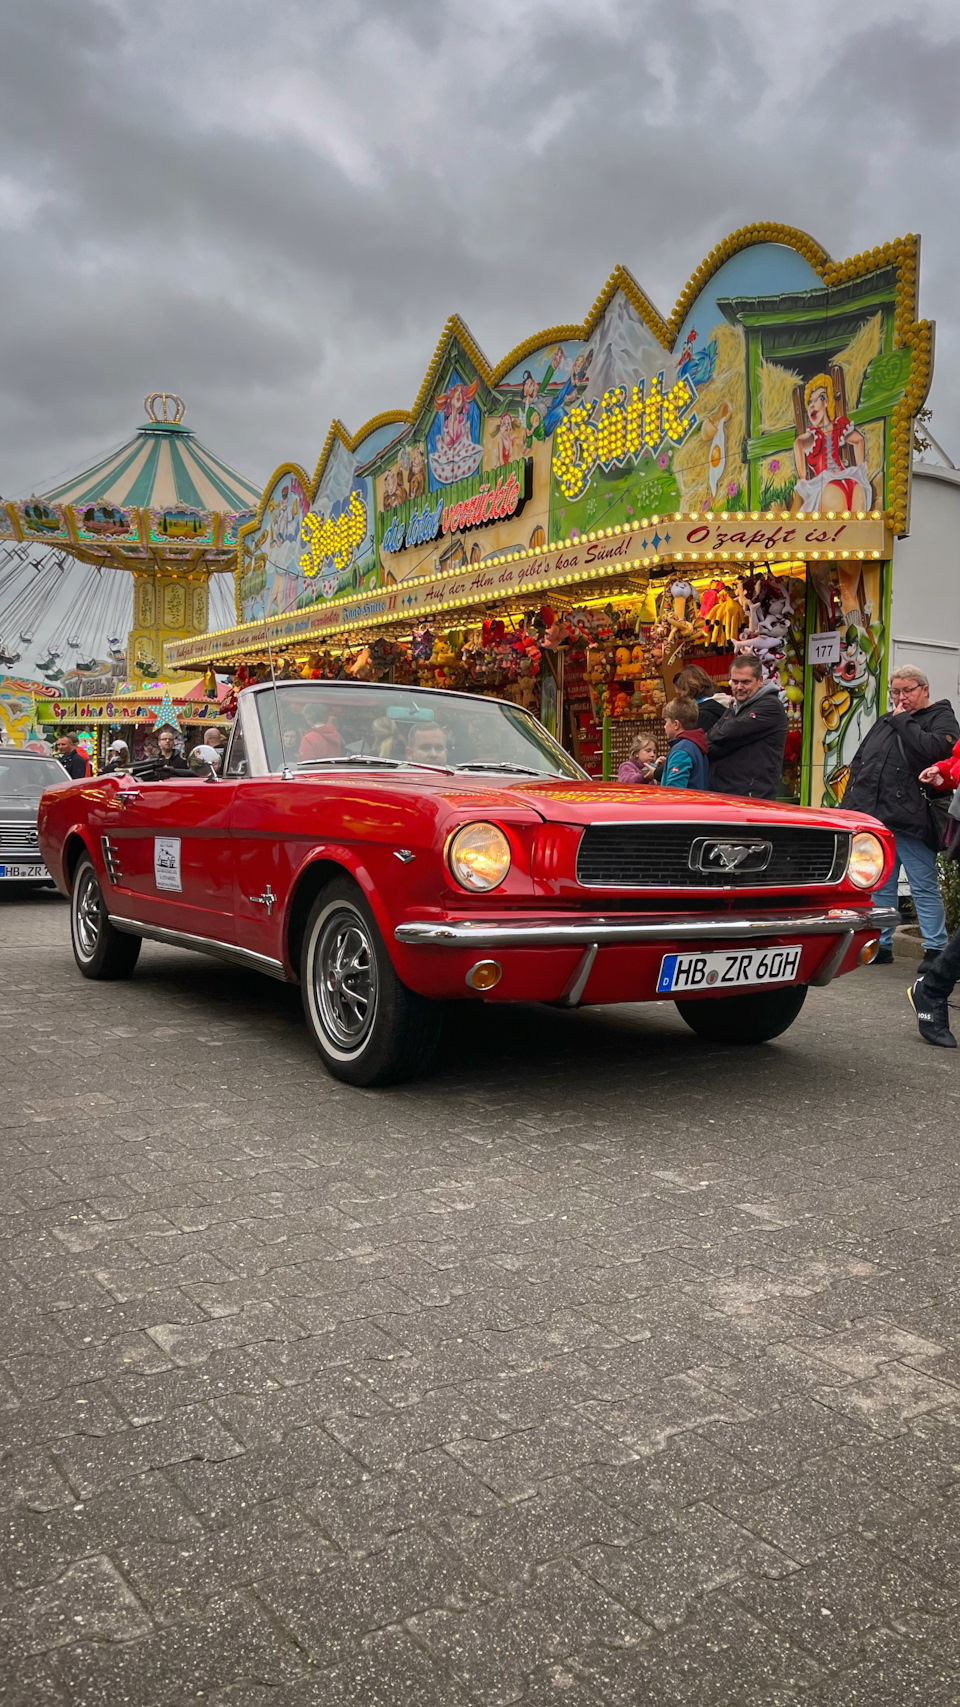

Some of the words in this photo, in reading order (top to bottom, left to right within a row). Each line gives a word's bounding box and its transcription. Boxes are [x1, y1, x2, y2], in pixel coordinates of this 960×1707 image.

[382, 515, 405, 552] die
[405, 498, 443, 547] total
[442, 471, 520, 534] verrückte
[686, 525, 796, 549] O'zapft
[804, 524, 847, 542] is!
[424, 584, 446, 602] Auf
[448, 581, 466, 596] der
[469, 572, 494, 591] Alm
[498, 567, 514, 583] da
[517, 556, 551, 585] gibt's
[555, 554, 578, 571] koa
[584, 536, 632, 565] Sünd!
[387, 594, 398, 611] II
[221, 638, 235, 648] mia
[236, 635, 250, 645] san
[815, 644, 834, 658] 177
[53, 702, 78, 721] Spiel
[80, 703, 103, 718] ohne
[106, 702, 149, 718] Grenzen
[5, 866, 20, 877] HB
[27, 866, 42, 877] ZR
[674, 958, 707, 987] HB
[720, 954, 753, 983] ZR
[755, 951, 799, 979] 60H
[662, 977, 670, 986] D
